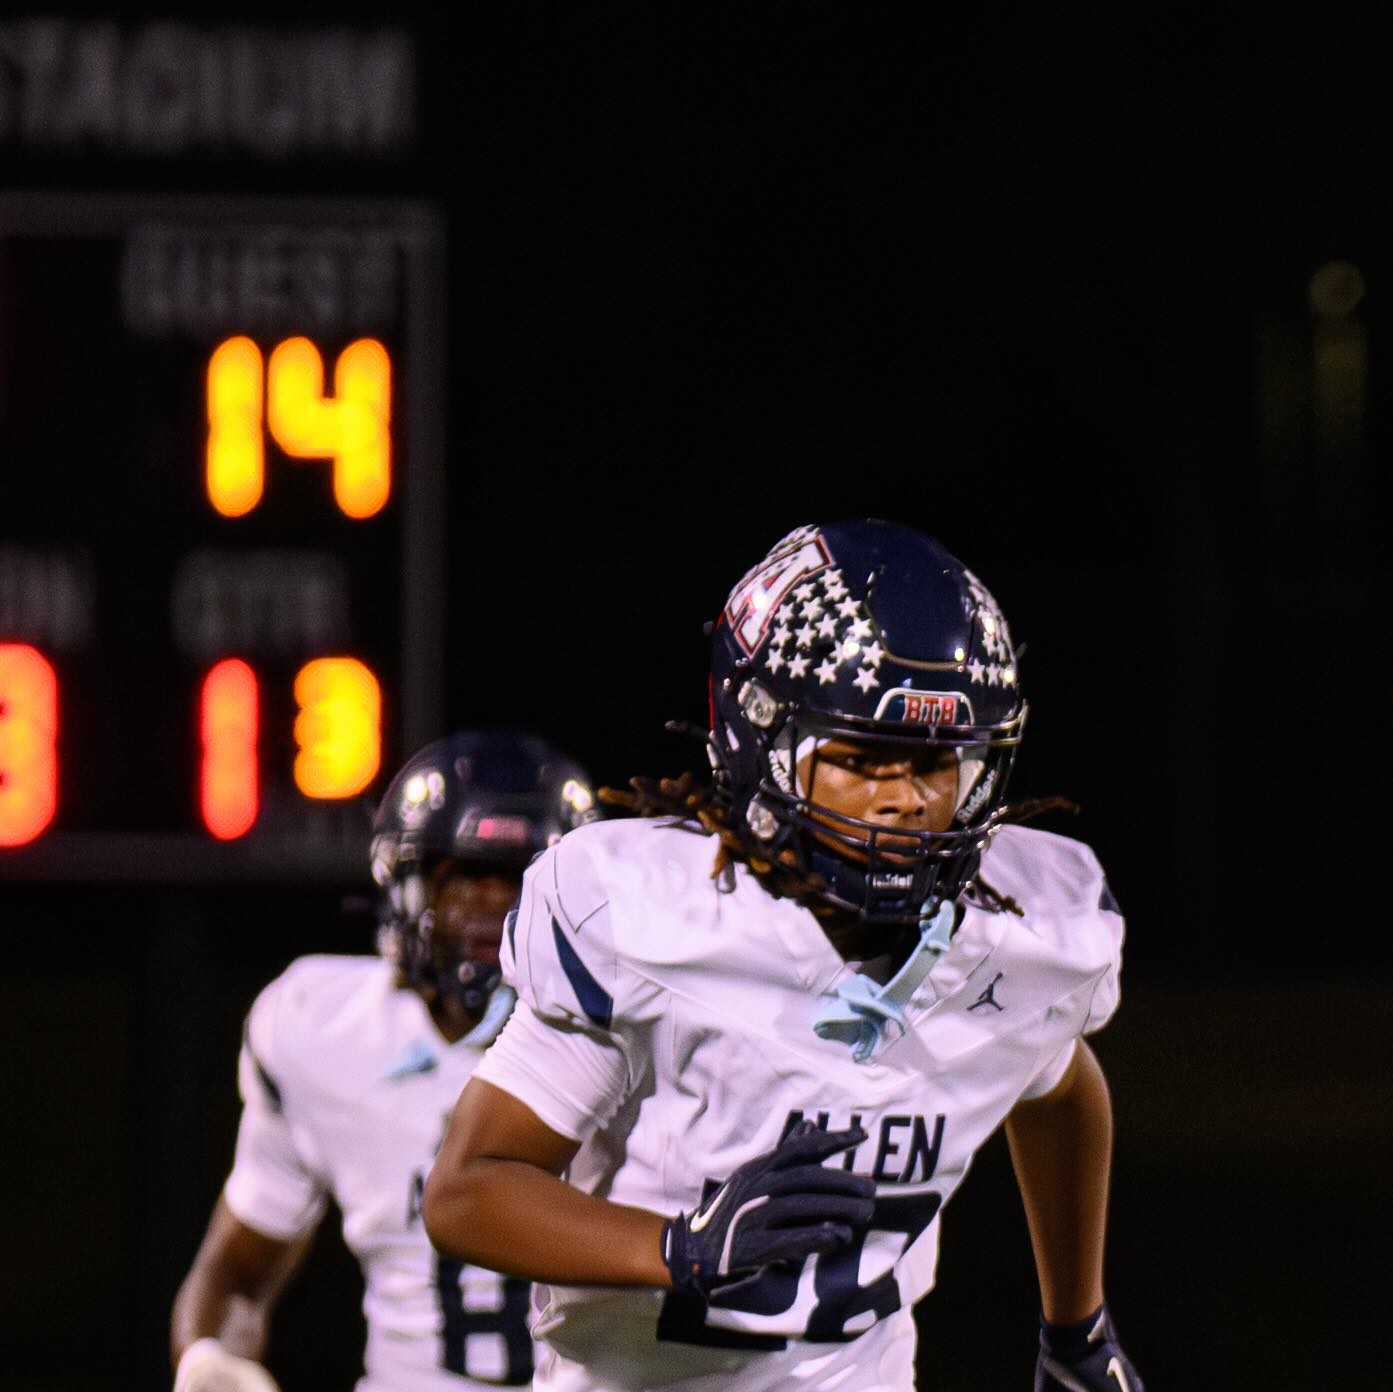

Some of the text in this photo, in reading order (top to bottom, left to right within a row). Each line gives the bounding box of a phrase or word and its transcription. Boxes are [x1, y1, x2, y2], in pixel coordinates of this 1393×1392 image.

[206, 336, 391, 519] 14
[201, 658, 259, 840] 1
[776, 1109, 946, 1183] LEN
